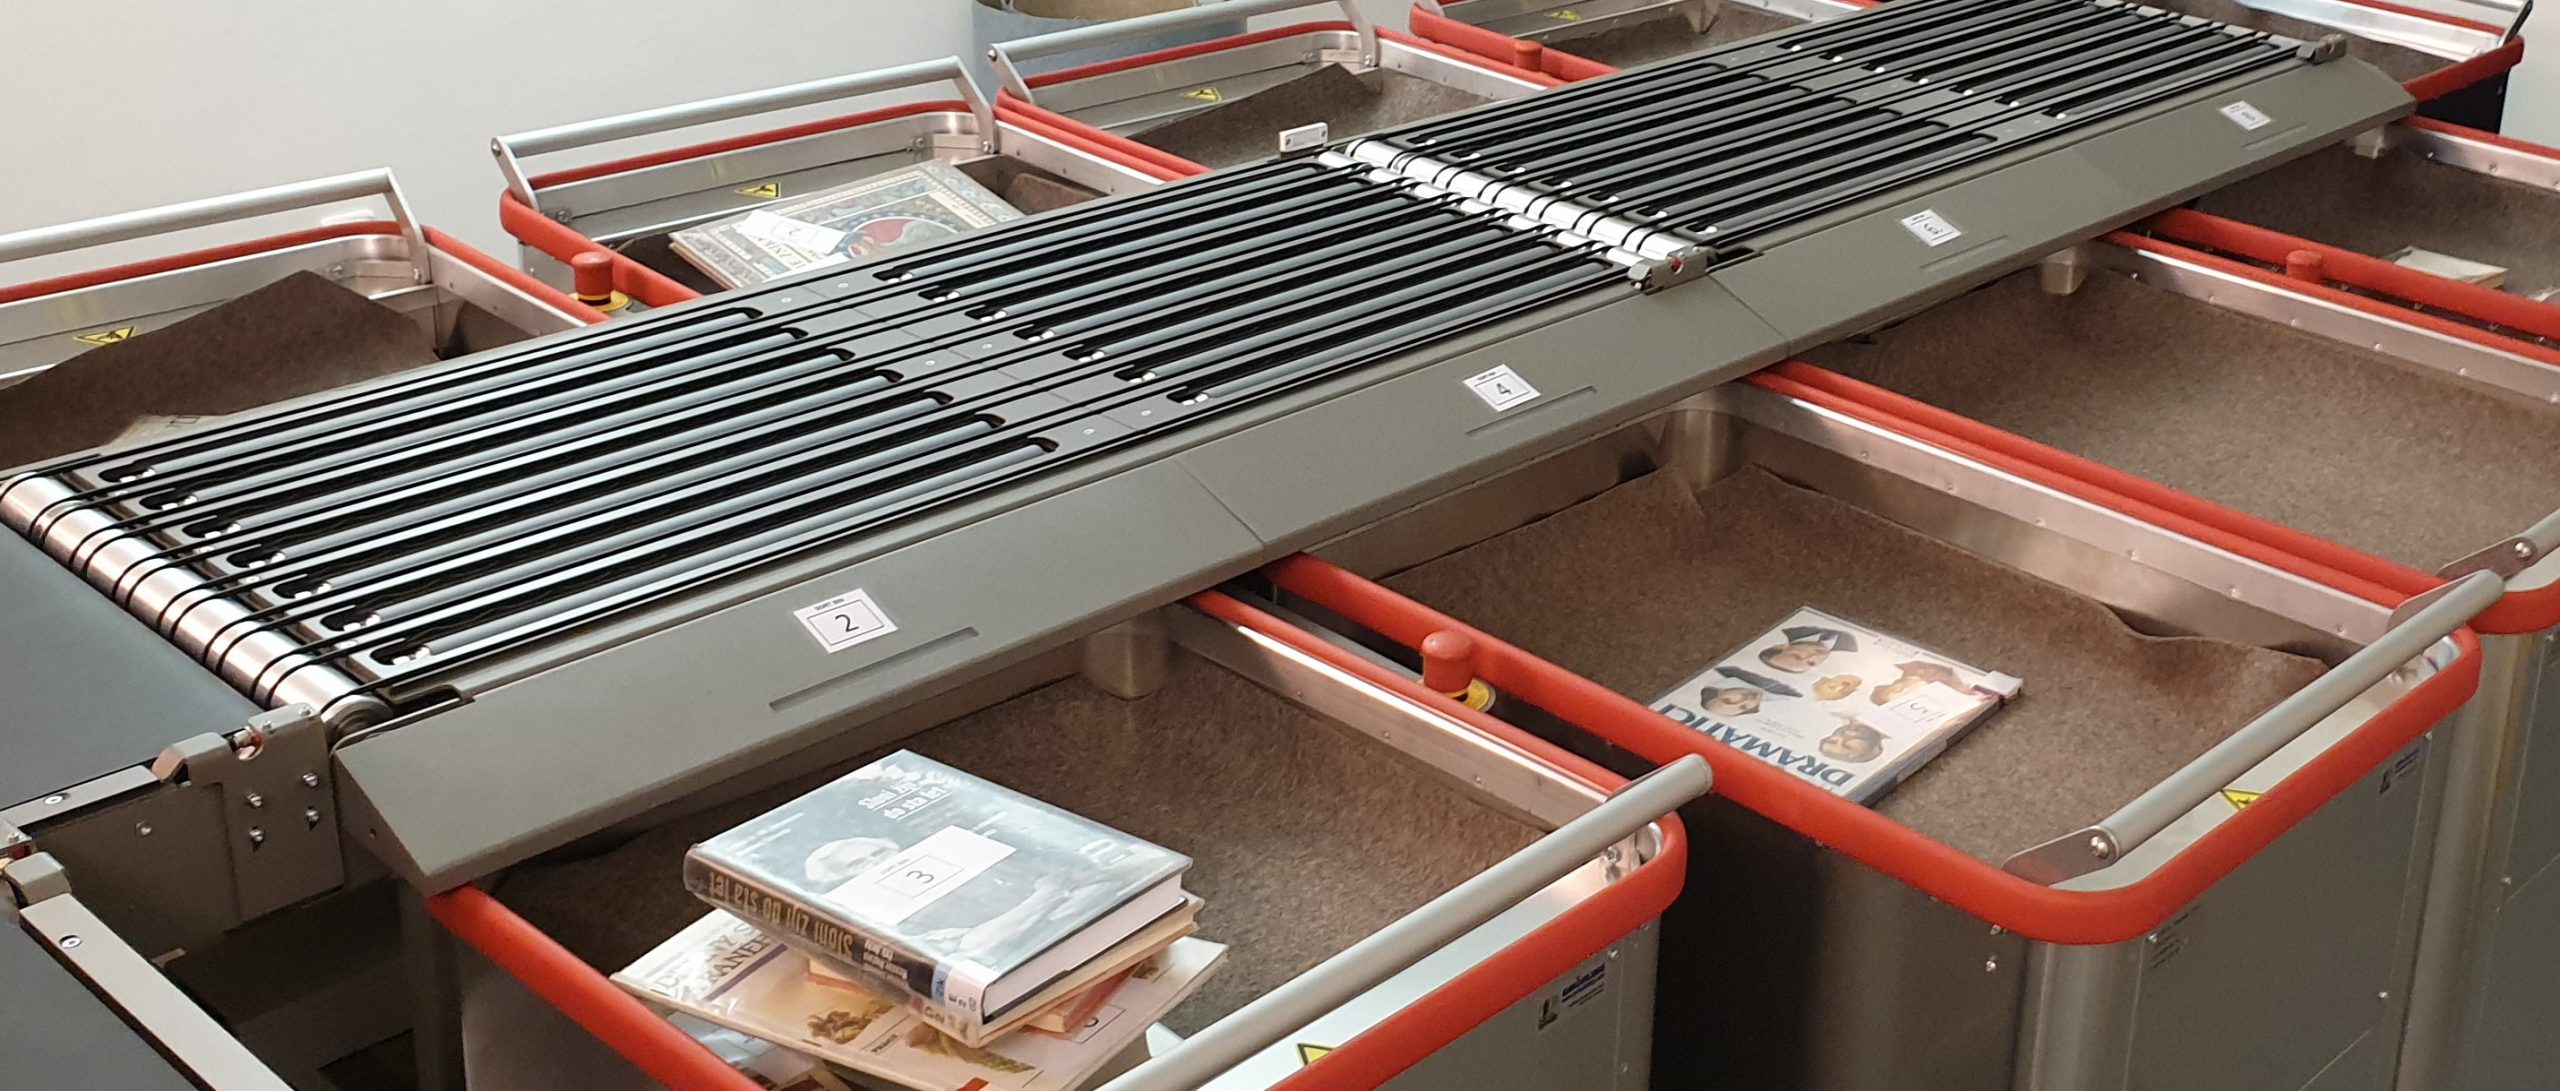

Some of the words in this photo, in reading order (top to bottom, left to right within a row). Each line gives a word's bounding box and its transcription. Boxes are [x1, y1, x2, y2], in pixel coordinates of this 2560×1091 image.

[1496, 382, 1512, 395] 4
[834, 613, 860, 633] 2
[1910, 702, 1929, 714] 5
[1659, 703, 1856, 788] DRAMATICI
[905, 869, 936, 885] 3
